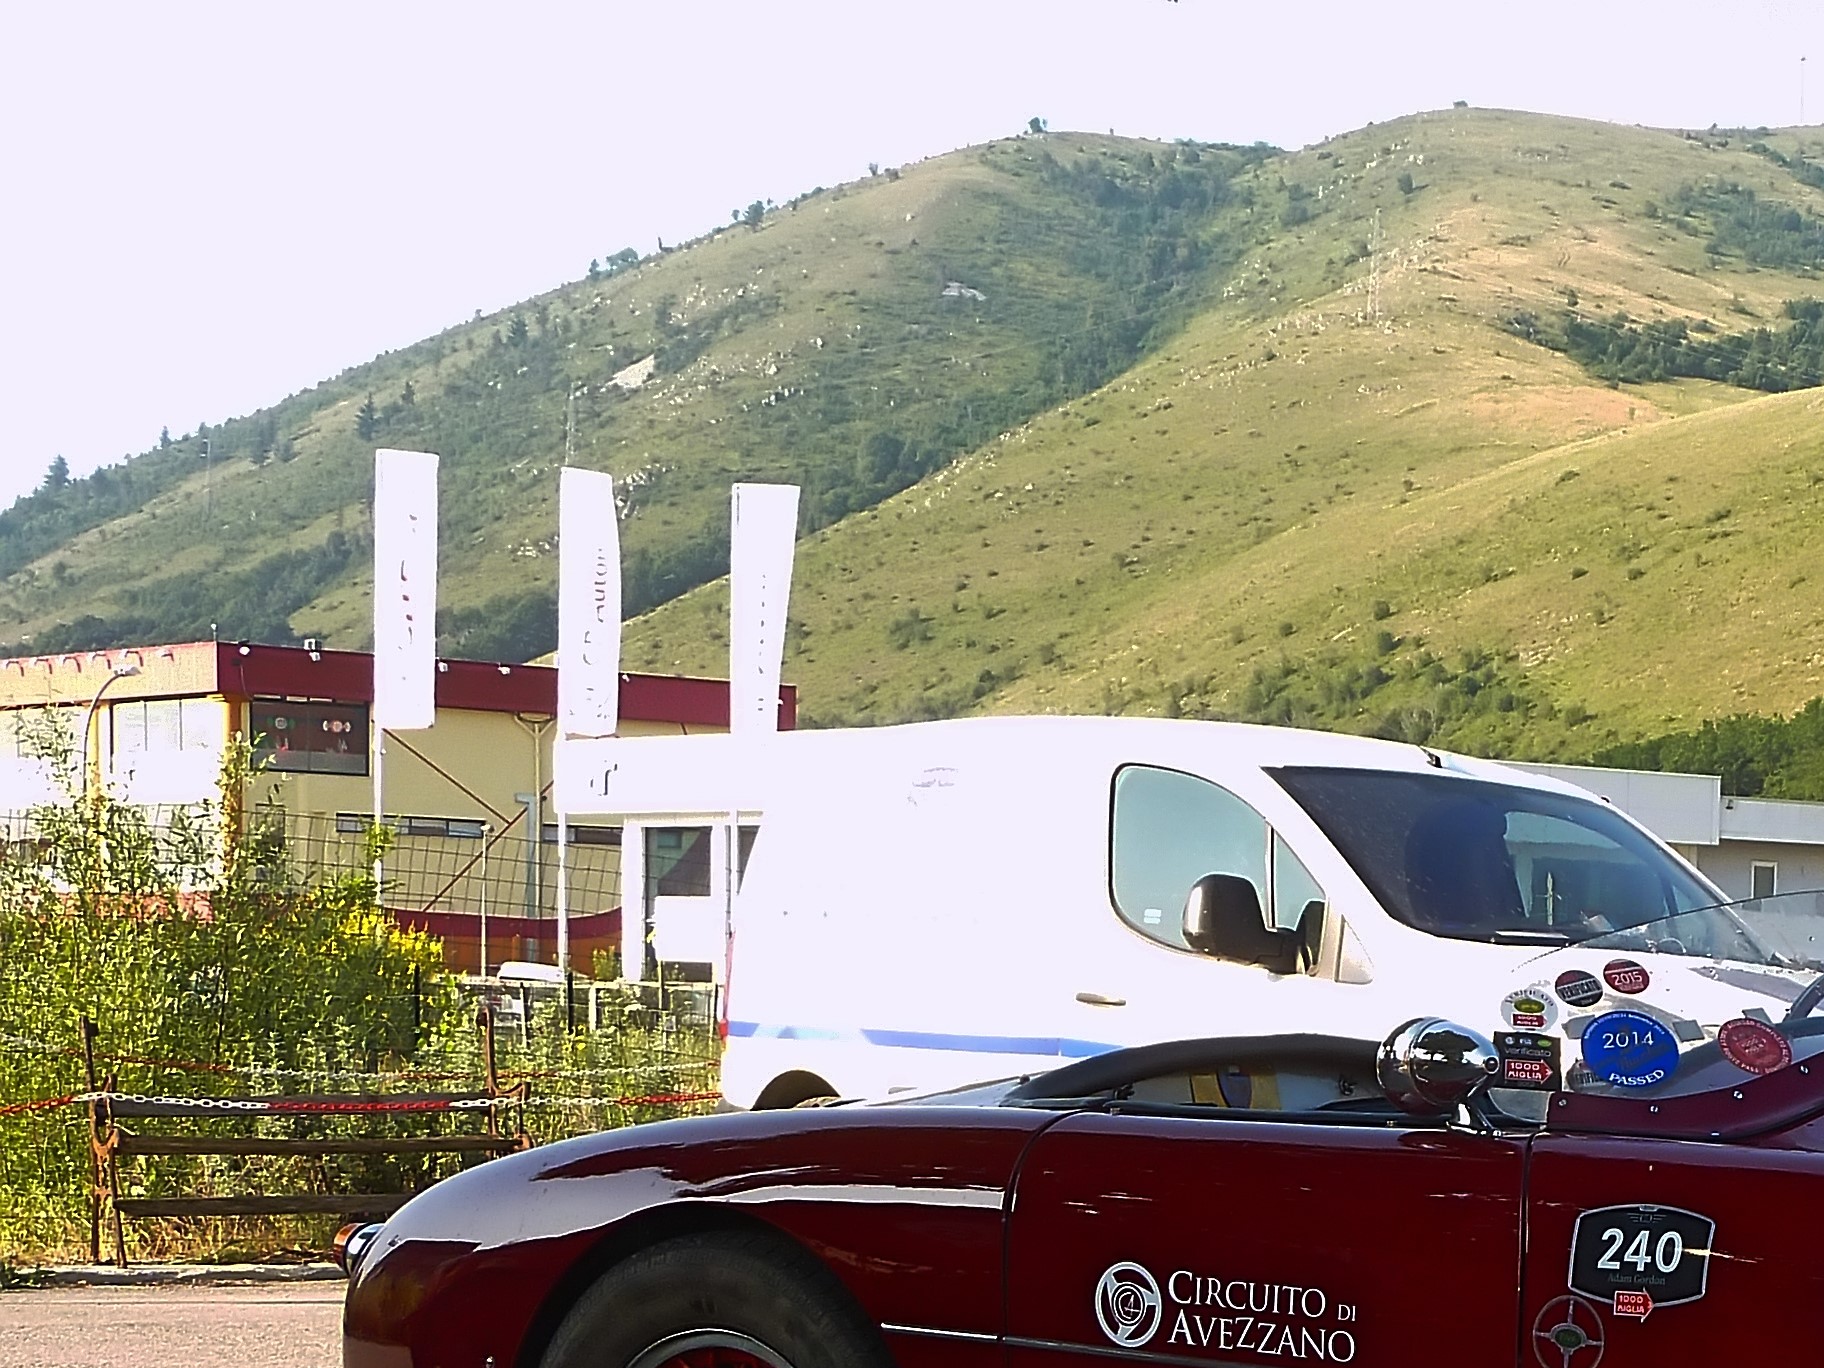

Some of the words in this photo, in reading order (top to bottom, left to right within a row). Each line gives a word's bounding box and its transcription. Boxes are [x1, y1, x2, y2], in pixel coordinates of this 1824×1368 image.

[1611, 971, 1647, 986] 2015
[1602, 1030, 1655, 1049] 2014
[1508, 1070, 1543, 1080] MIGLIA
[1510, 1062, 1541, 1072] 1000
[1608, 1069, 1665, 1086] PASSED
[1597, 1227, 1683, 1273] 240
[1168, 1270, 1326, 1318] CIRCUITO
[1619, 1295, 1644, 1304] 1000
[1617, 1304, 1645, 1313] MIGLIA
[1167, 1309, 1356, 1364] AVEZZANO
